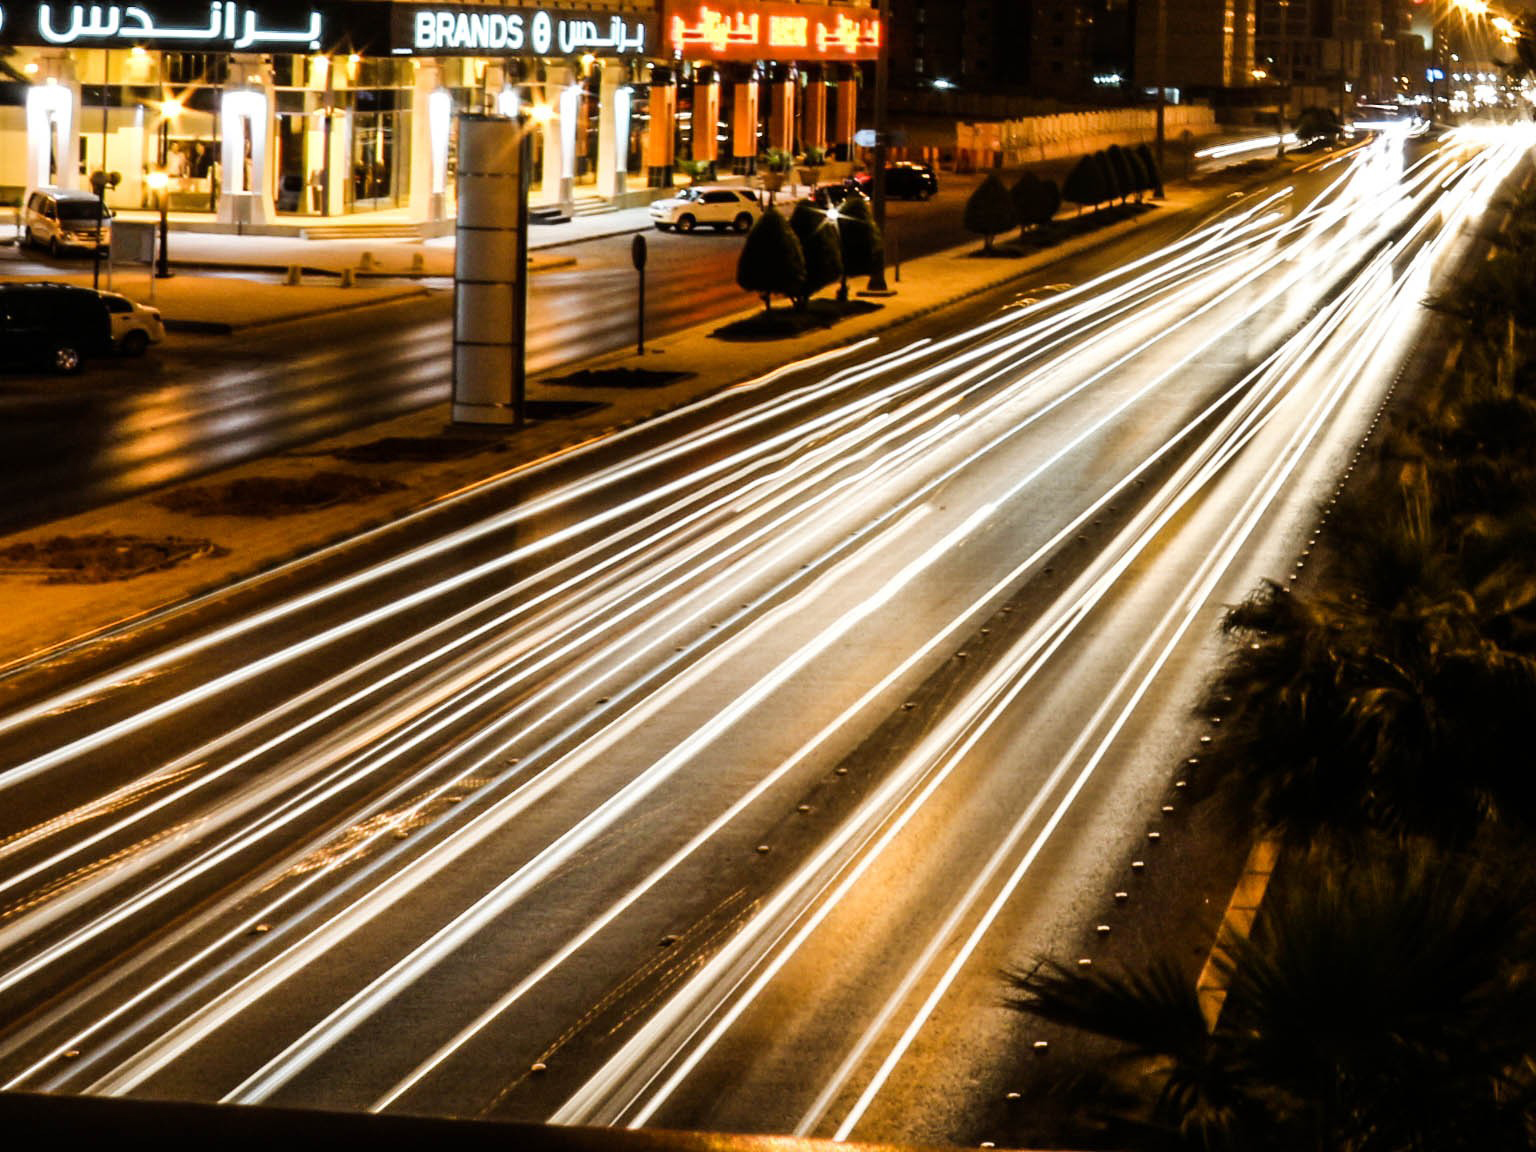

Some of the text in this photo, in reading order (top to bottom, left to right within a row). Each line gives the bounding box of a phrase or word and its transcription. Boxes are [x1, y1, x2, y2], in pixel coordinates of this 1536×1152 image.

[38, 1, 322, 49] براندس
[415, 11, 524, 49] BRANDS
[558, 15, 645, 54] براندس
